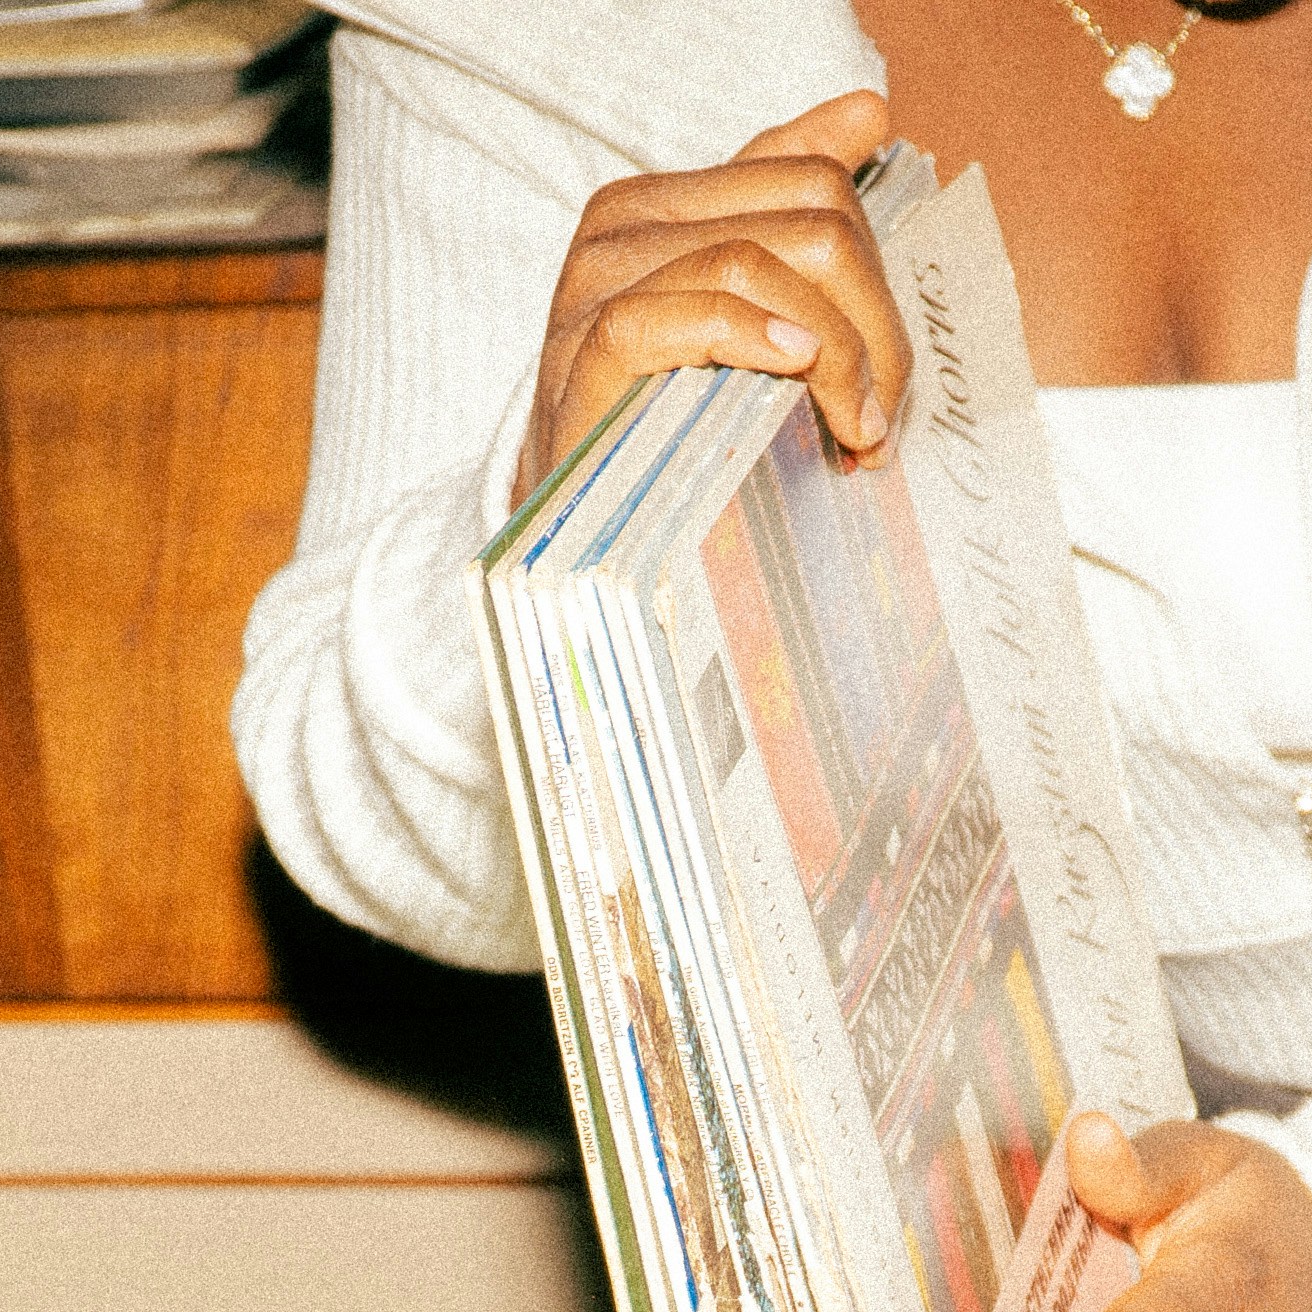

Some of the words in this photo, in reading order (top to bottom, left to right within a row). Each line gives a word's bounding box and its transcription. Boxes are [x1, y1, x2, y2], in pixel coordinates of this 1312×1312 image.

[912, 256, 991, 502] Chorus
[545, 956, 559, 982] ODD
[571, 1082, 585, 1104] ALF
